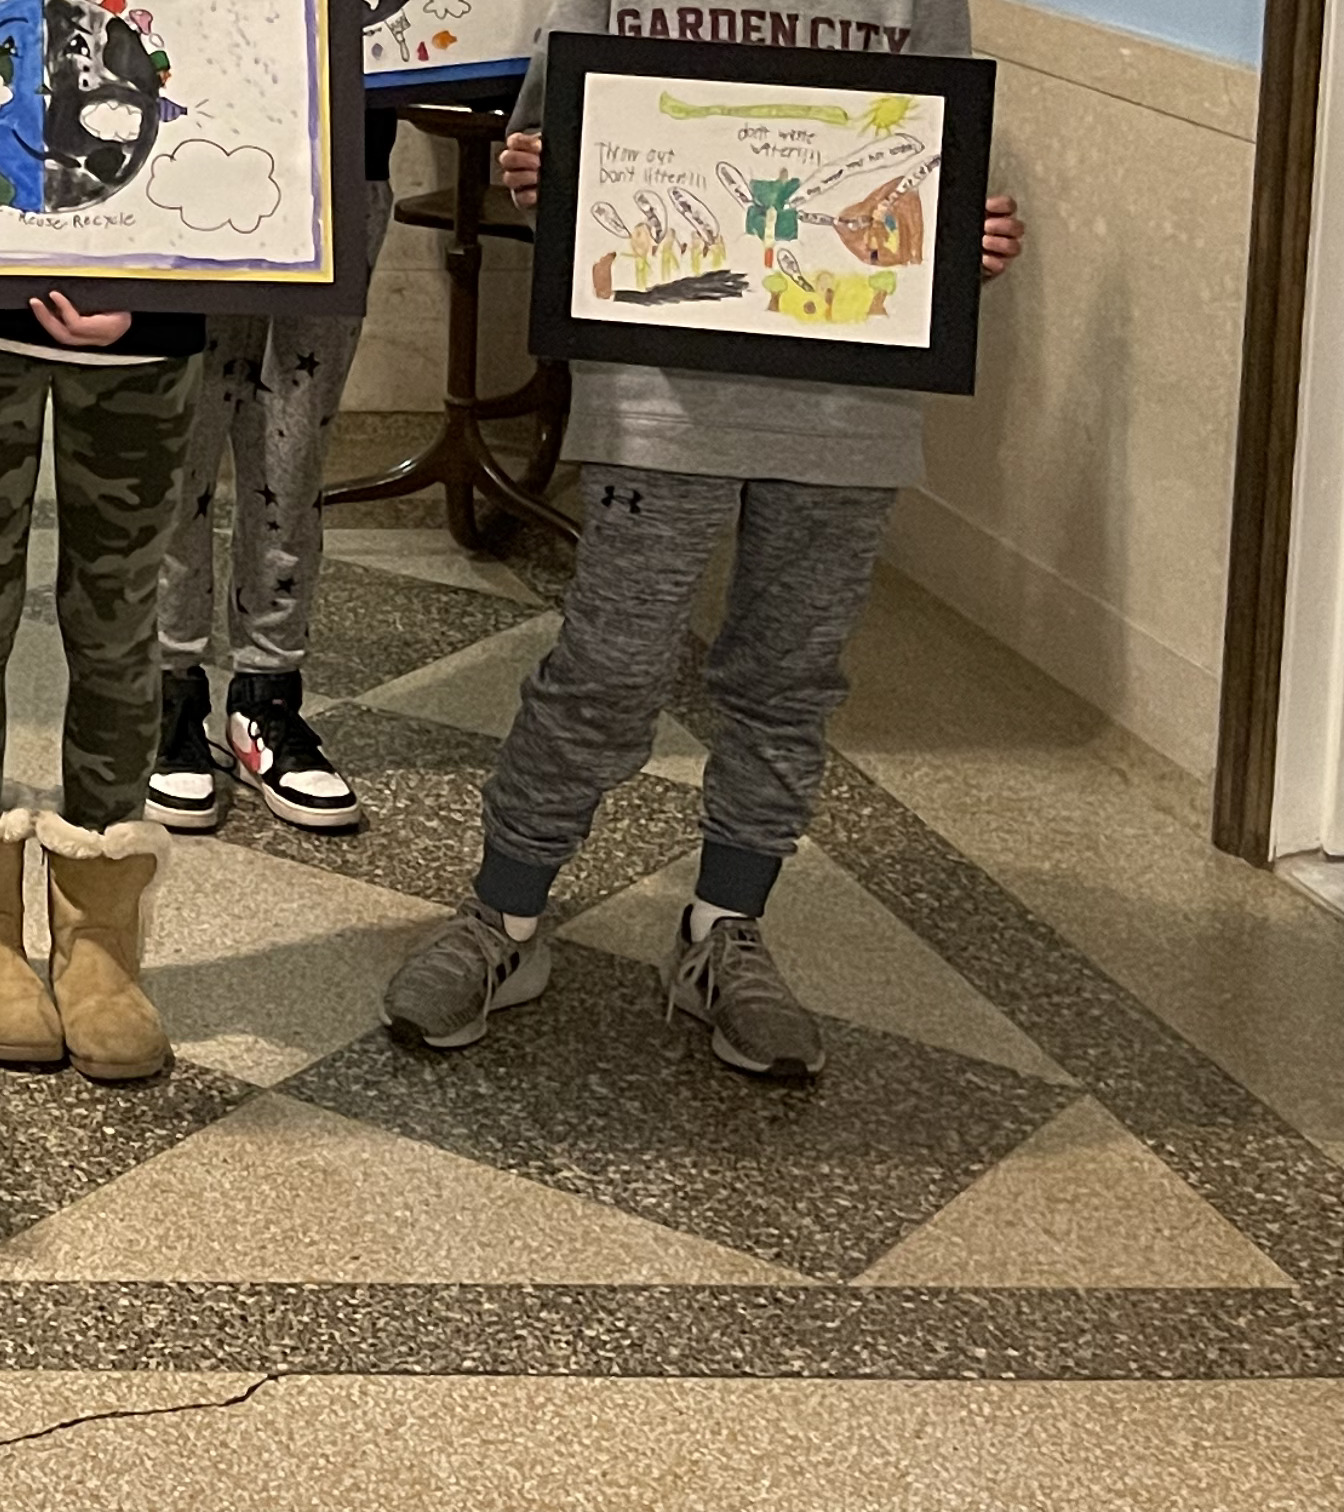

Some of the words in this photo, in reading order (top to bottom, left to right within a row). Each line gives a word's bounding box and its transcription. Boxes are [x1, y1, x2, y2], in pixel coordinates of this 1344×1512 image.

[616, 7, 800, 47] GARDEN
[810, 16, 911, 53] CITY
[594, 141, 640, 165] Throw
[645, 147, 675, 163] out
[72, 211, 137, 230] Recycle
